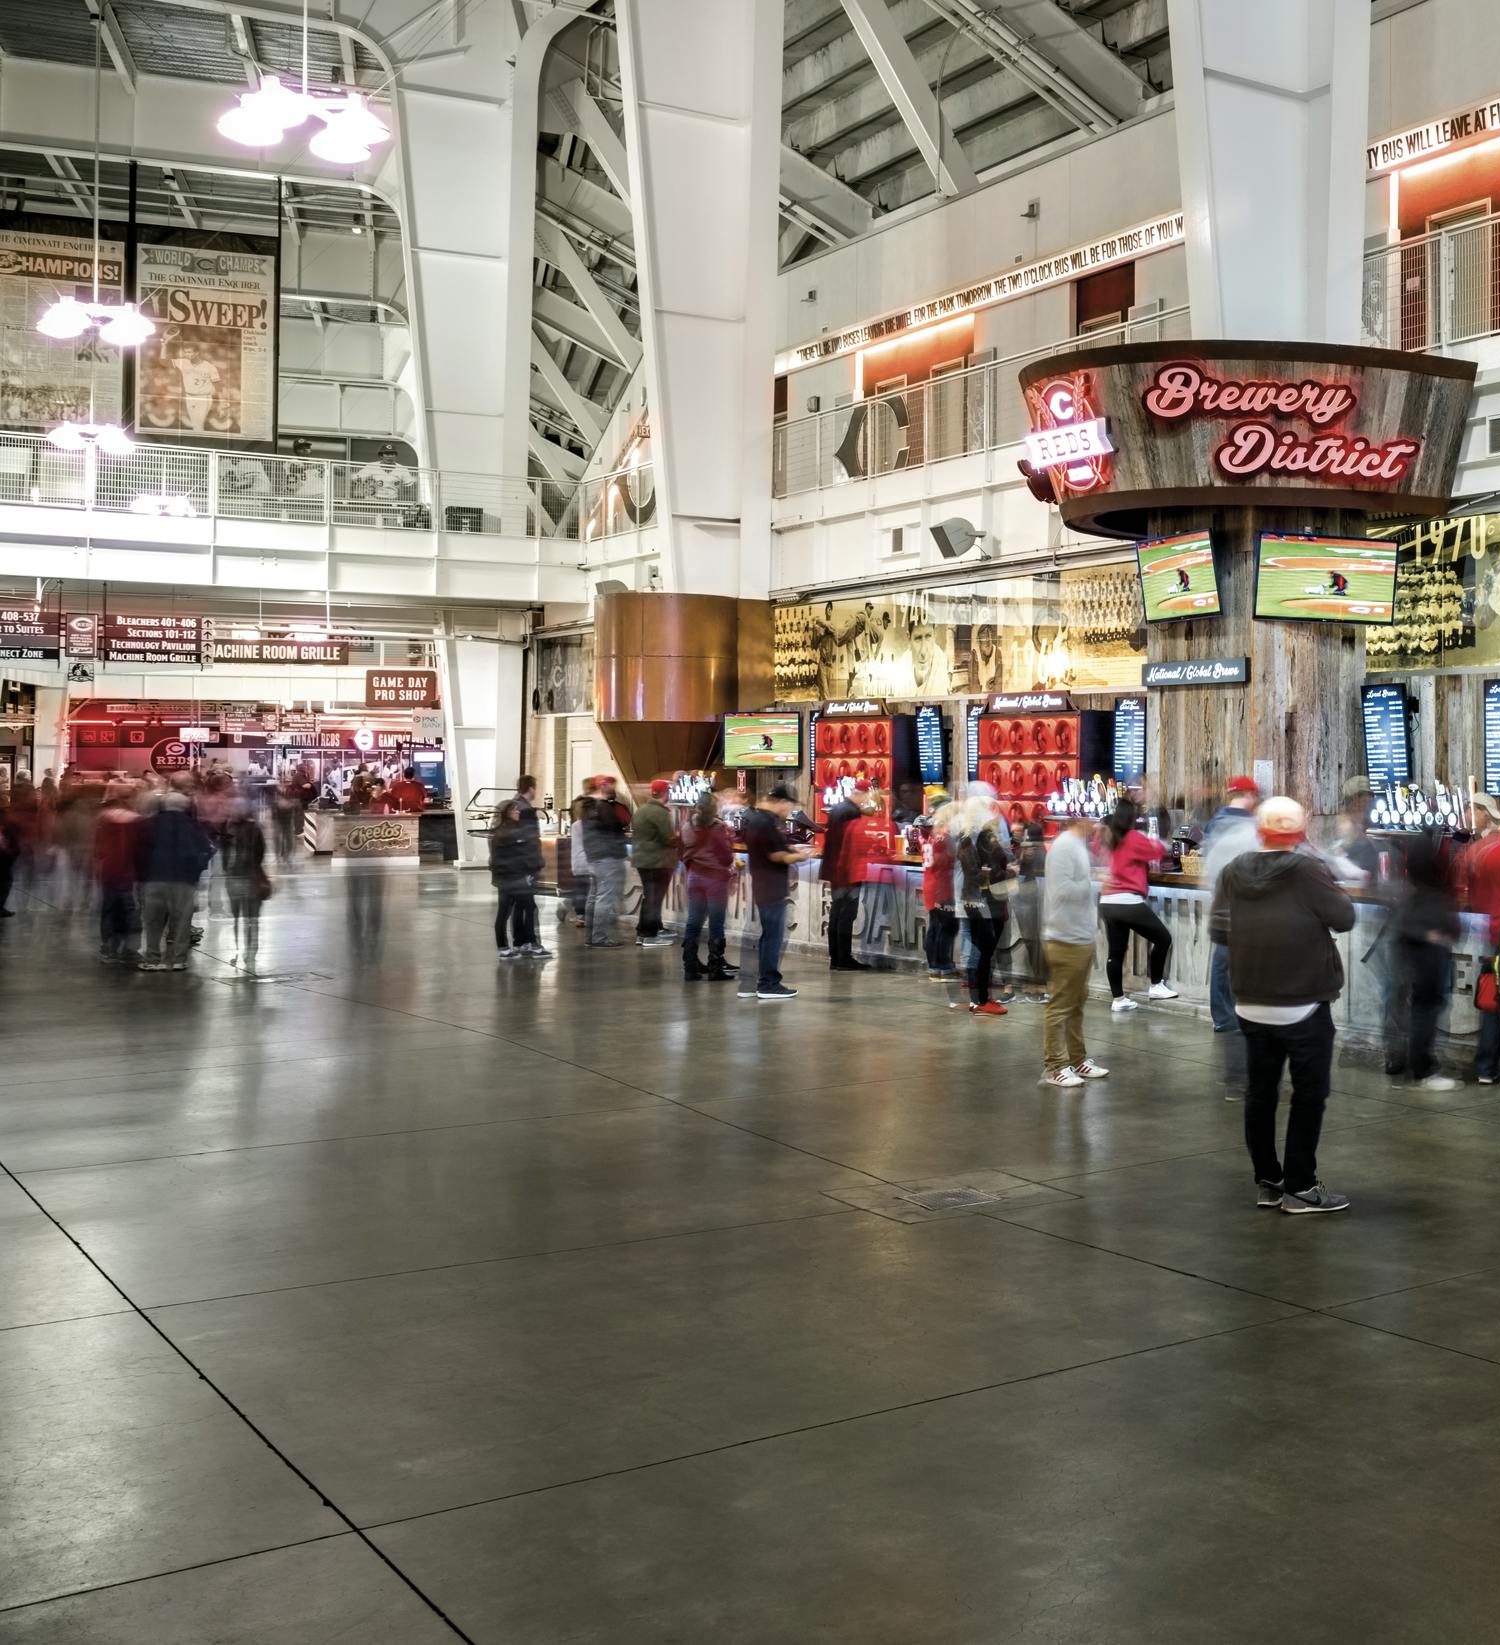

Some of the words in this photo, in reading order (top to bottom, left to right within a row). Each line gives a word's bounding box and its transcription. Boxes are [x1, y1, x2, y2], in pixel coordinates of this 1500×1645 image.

[1366, 147, 1380, 170] TY
[1382, 138, 1404, 164] BUS
[1405, 129, 1433, 156] WILL
[1435, 115, 1472, 144] LEAVE
[1473, 107, 1490, 132] AT
[14, 236, 61, 249] CINCINNATI
[63, 241, 105, 253] ENQUIRR
[155, 249, 191, 266] WORLD
[219, 256, 260, 270] CHAMPS
[148, 271, 166, 281] THE
[168, 274, 216, 287] CINCINNATI
[218, 278, 261, 290] ENQUIRER
[842, 331, 861, 349] BUSES
[860, 322, 885, 343] LEAVING
[914, 306, 927, 323] FOR
[926, 302, 939, 319] THE
[938, 295, 955, 316] PARK
[956, 283, 994, 309] TOMORROW.
[994, 279, 1007, 296] THE
[1007, 273, 1022, 293] TWO
[1023, 262, 1053, 287] O'CLOCK
[1054, 257, 1070, 277] BUS
[1069, 249, 1089, 272] WILL
[1090, 245, 1100, 264] BE
[1101, 240, 1118, 262] FOR
[1118, 230, 1143, 255] THOSE
[1144, 225, 1156, 245] OF
[1156, 220, 1174, 242] YOU
[168, 289, 268, 330] SWEEP!
[1146, 367, 1352, 424] Brewery
[1049, 391, 1074, 420] C
[1037, 428, 1092, 460] REDS
[1219, 424, 1416, 479] District
[1415, 514, 1486, 566] 1970
[1, 611, 40, 622] 408-537
[116, 615, 160, 626] BLEACHERS
[160, 617, 197, 628] 401-406
[4, 625, 15, 634] TO
[15, 624, 45, 634] SUITES
[127, 627, 163, 638] SECTIONS
[165, 629, 197, 640] 101-112
[0, 649, 20, 657] NECT
[22, 648, 44, 658] ZONE
[110, 639, 160, 650] TECHNOLOGY
[161, 640, 197, 651] PAVILION
[262, 645, 298, 660] ROOM
[300, 646, 341, 661] GRILLE
[109, 651, 145, 661] MACHINE
[145, 652, 168, 662] ROOM
[169, 653, 197, 663] GRILLE
[1146, 666, 1181, 682] National
[1186, 665, 1212, 680] Global
[1212, 662, 1240, 679] Brews
[372, 676, 404, 688] GAME
[407, 676, 429, 688] DAY
[374, 690, 396, 701] PRO
[398, 690, 428, 701] SHOP
[292, 734, 319, 747] INNATI
[320, 733, 340, 747] REDS
